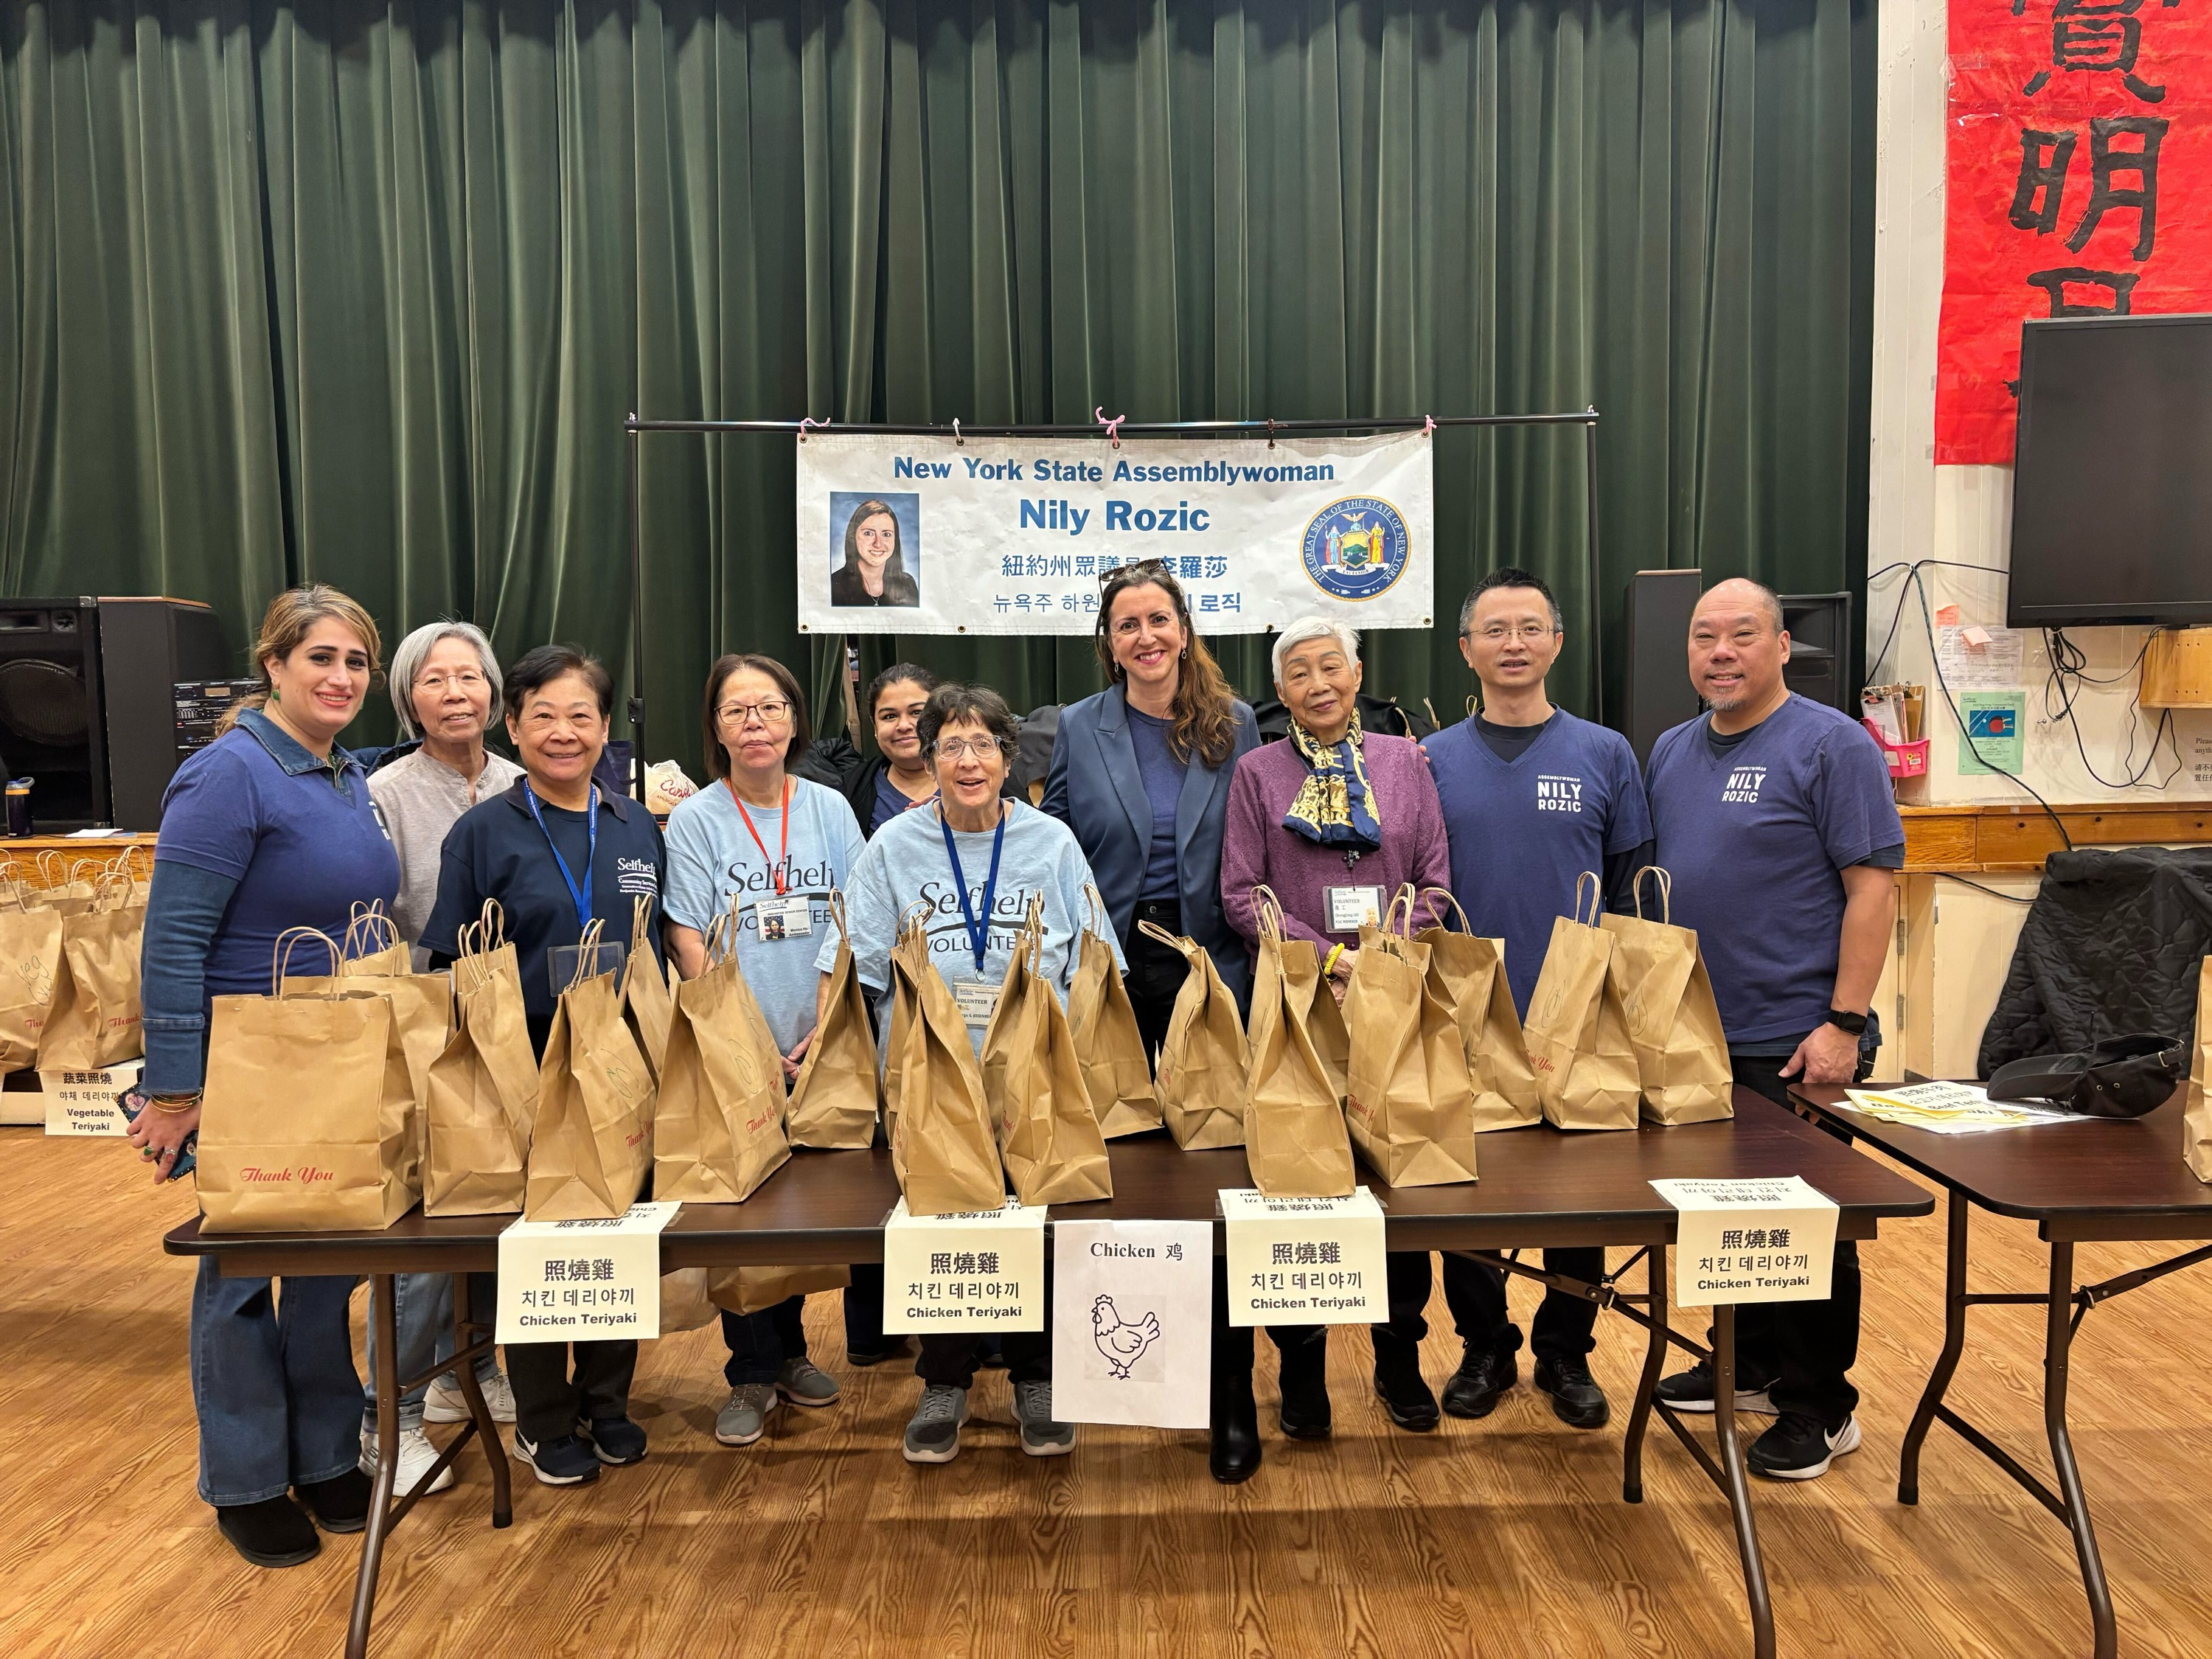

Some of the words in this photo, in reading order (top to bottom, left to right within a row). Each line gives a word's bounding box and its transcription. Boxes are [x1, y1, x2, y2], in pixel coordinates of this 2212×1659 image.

[894, 456, 951, 479] New
[964, 458, 1022, 481] York
[1034, 460, 1102, 481] State
[1113, 460, 1335, 485] Assemblywoman
[1330, 504, 1343, 514] OF
[1345, 499, 1364, 508] THE
[1366, 500, 1394, 518] STATE
[1020, 498, 1090, 536] Nily
[1105, 500, 1210, 532] Rozic
[1310, 513, 1330, 533] SEAL
[1391, 517, 1402, 531] OF
[1305, 535, 1315, 564] GREAT
[1397, 532, 1406, 555] NEW
[1310, 566, 1323, 582] THE
[1382, 558, 1404, 582] YORK
[993, 593, 1054, 613] 뉴욕주
[1061, 593, 1100, 613] 하원
[1199, 592, 1241, 613] 로직
[1726, 773, 1767, 790] NILY
[1537, 782, 1582, 800] NILY
[1722, 790, 1759, 804] ROZIC
[1538, 799, 1582, 813] ROZIC
[24, 1019, 44, 1029] Tha
[108, 1013, 140, 1027] Thank
[1538, 1056, 1555, 1073] You
[62, 1072, 113, 1085] 蔬菜照燒
[60, 1091, 77, 1101] 야채
[67, 1108, 114, 1119] Vegetable
[72, 1121, 110, 1133] Teriyaki
[746, 1112, 767, 1134] Thank
[240, 1167, 292, 1181] Thank
[296, 1166, 334, 1185] You
[1721, 1228, 1791, 1250] 照燒雞
[1090, 1242, 1156, 1259] Chicken
[1165, 1242, 1183, 1262] 鸡
[1272, 1242, 1342, 1265] 照燒雞
[544, 1258, 615, 1282] 照燒雞
[930, 1251, 1000, 1275] 照燒雞
[1699, 1256, 1732, 1273] 치킨
[1739, 1254, 1809, 1272] 데리야끼
[1251, 1273, 1284, 1291] 치킨
[1292, 1271, 1362, 1290] 데리야끼
[1697, 1279, 1752, 1290] Chicken
[1756, 1276, 1810, 1289] Teriyaki
[521, 1290, 555, 1307] 치킨
[563, 1287, 635, 1307] 데리야끼
[908, 1282, 942, 1300] 치킨
[949, 1281, 1019, 1300] 데리야끼
[1251, 1298, 1306, 1310] Chicken
[1310, 1296, 1366, 1310] Teriyaki
[519, 1315, 576, 1326] Chicken
[580, 1312, 637, 1326] Teriyaki
[906, 1307, 962, 1318] Chicken
[966, 1306, 1023, 1319] Teriyaki
